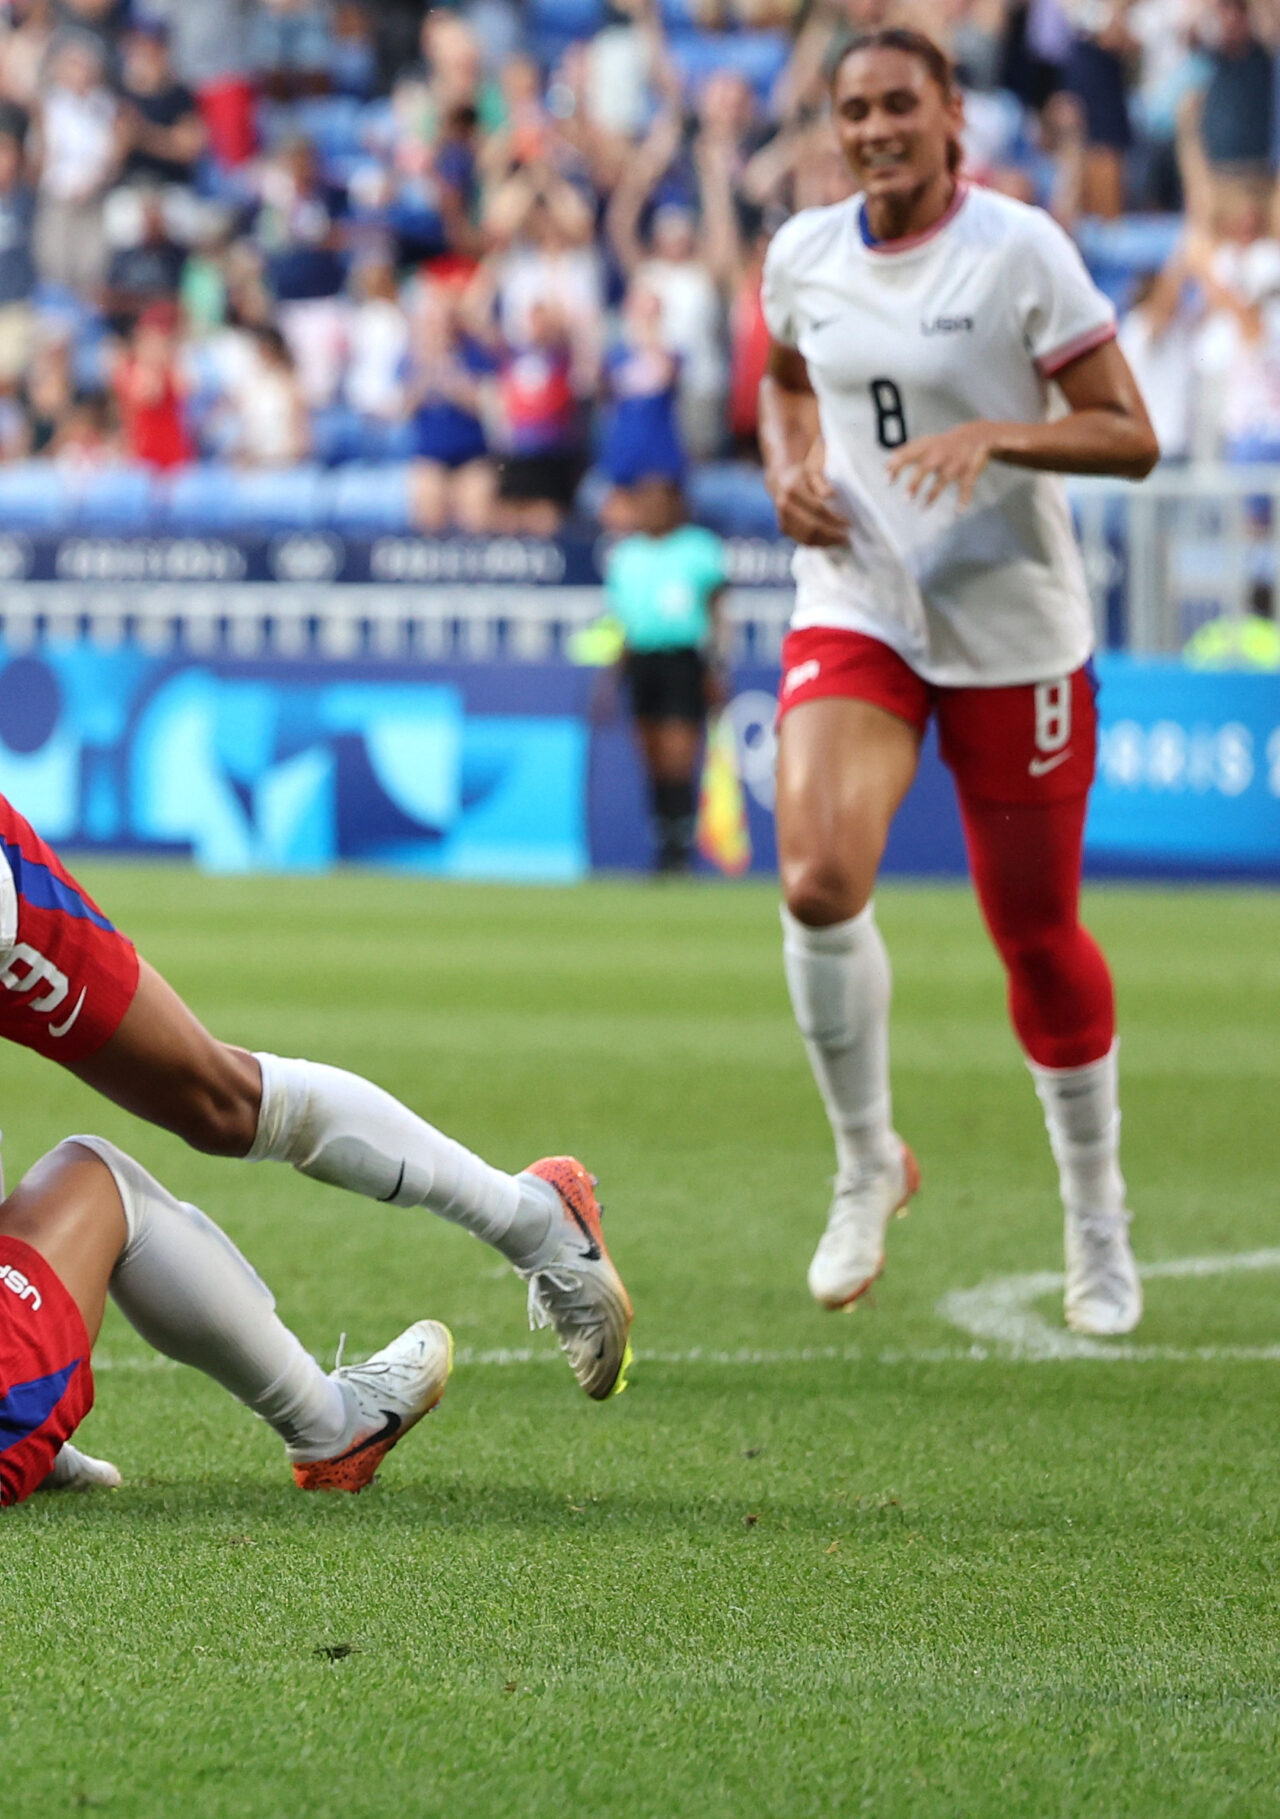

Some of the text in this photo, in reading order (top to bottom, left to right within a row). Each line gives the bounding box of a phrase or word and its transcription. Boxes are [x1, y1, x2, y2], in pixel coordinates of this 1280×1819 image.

[870, 377, 908, 448] 8
[1034, 676, 1071, 752] 8
[1100, 718, 1254, 796] ARIS
